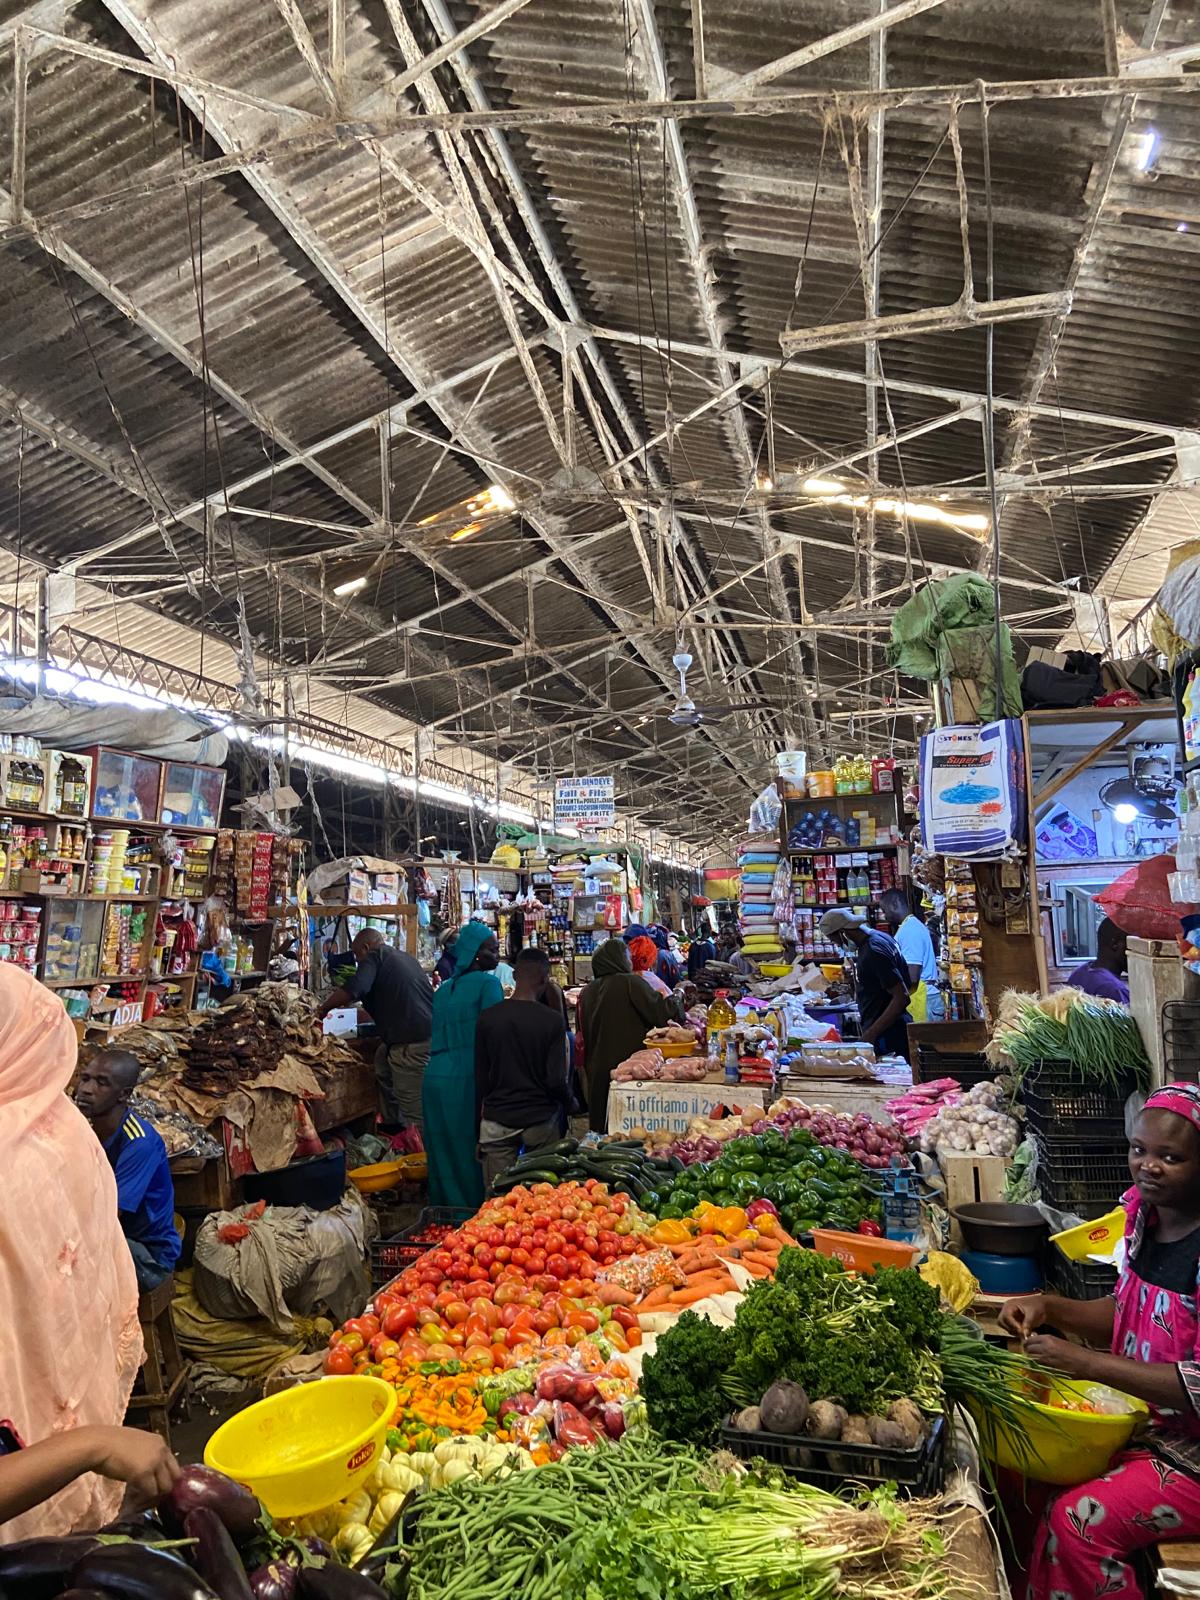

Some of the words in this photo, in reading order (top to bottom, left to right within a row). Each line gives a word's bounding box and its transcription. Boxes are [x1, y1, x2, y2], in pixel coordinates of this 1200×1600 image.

[947, 755, 977, 764] Super
[559, 789, 577, 798] Fall
[588, 789, 606, 797] Fils
[112, 1004, 142, 1026] ADJA
[626, 1096, 635, 1112] Ti
[639, 1096, 688, 1113] offriamo
[691, 1098, 698, 1115] il
[702, 1099, 720, 1115] 2x
[623, 1117, 636, 1130] su
[640, 1115, 670, 1131] tanti
